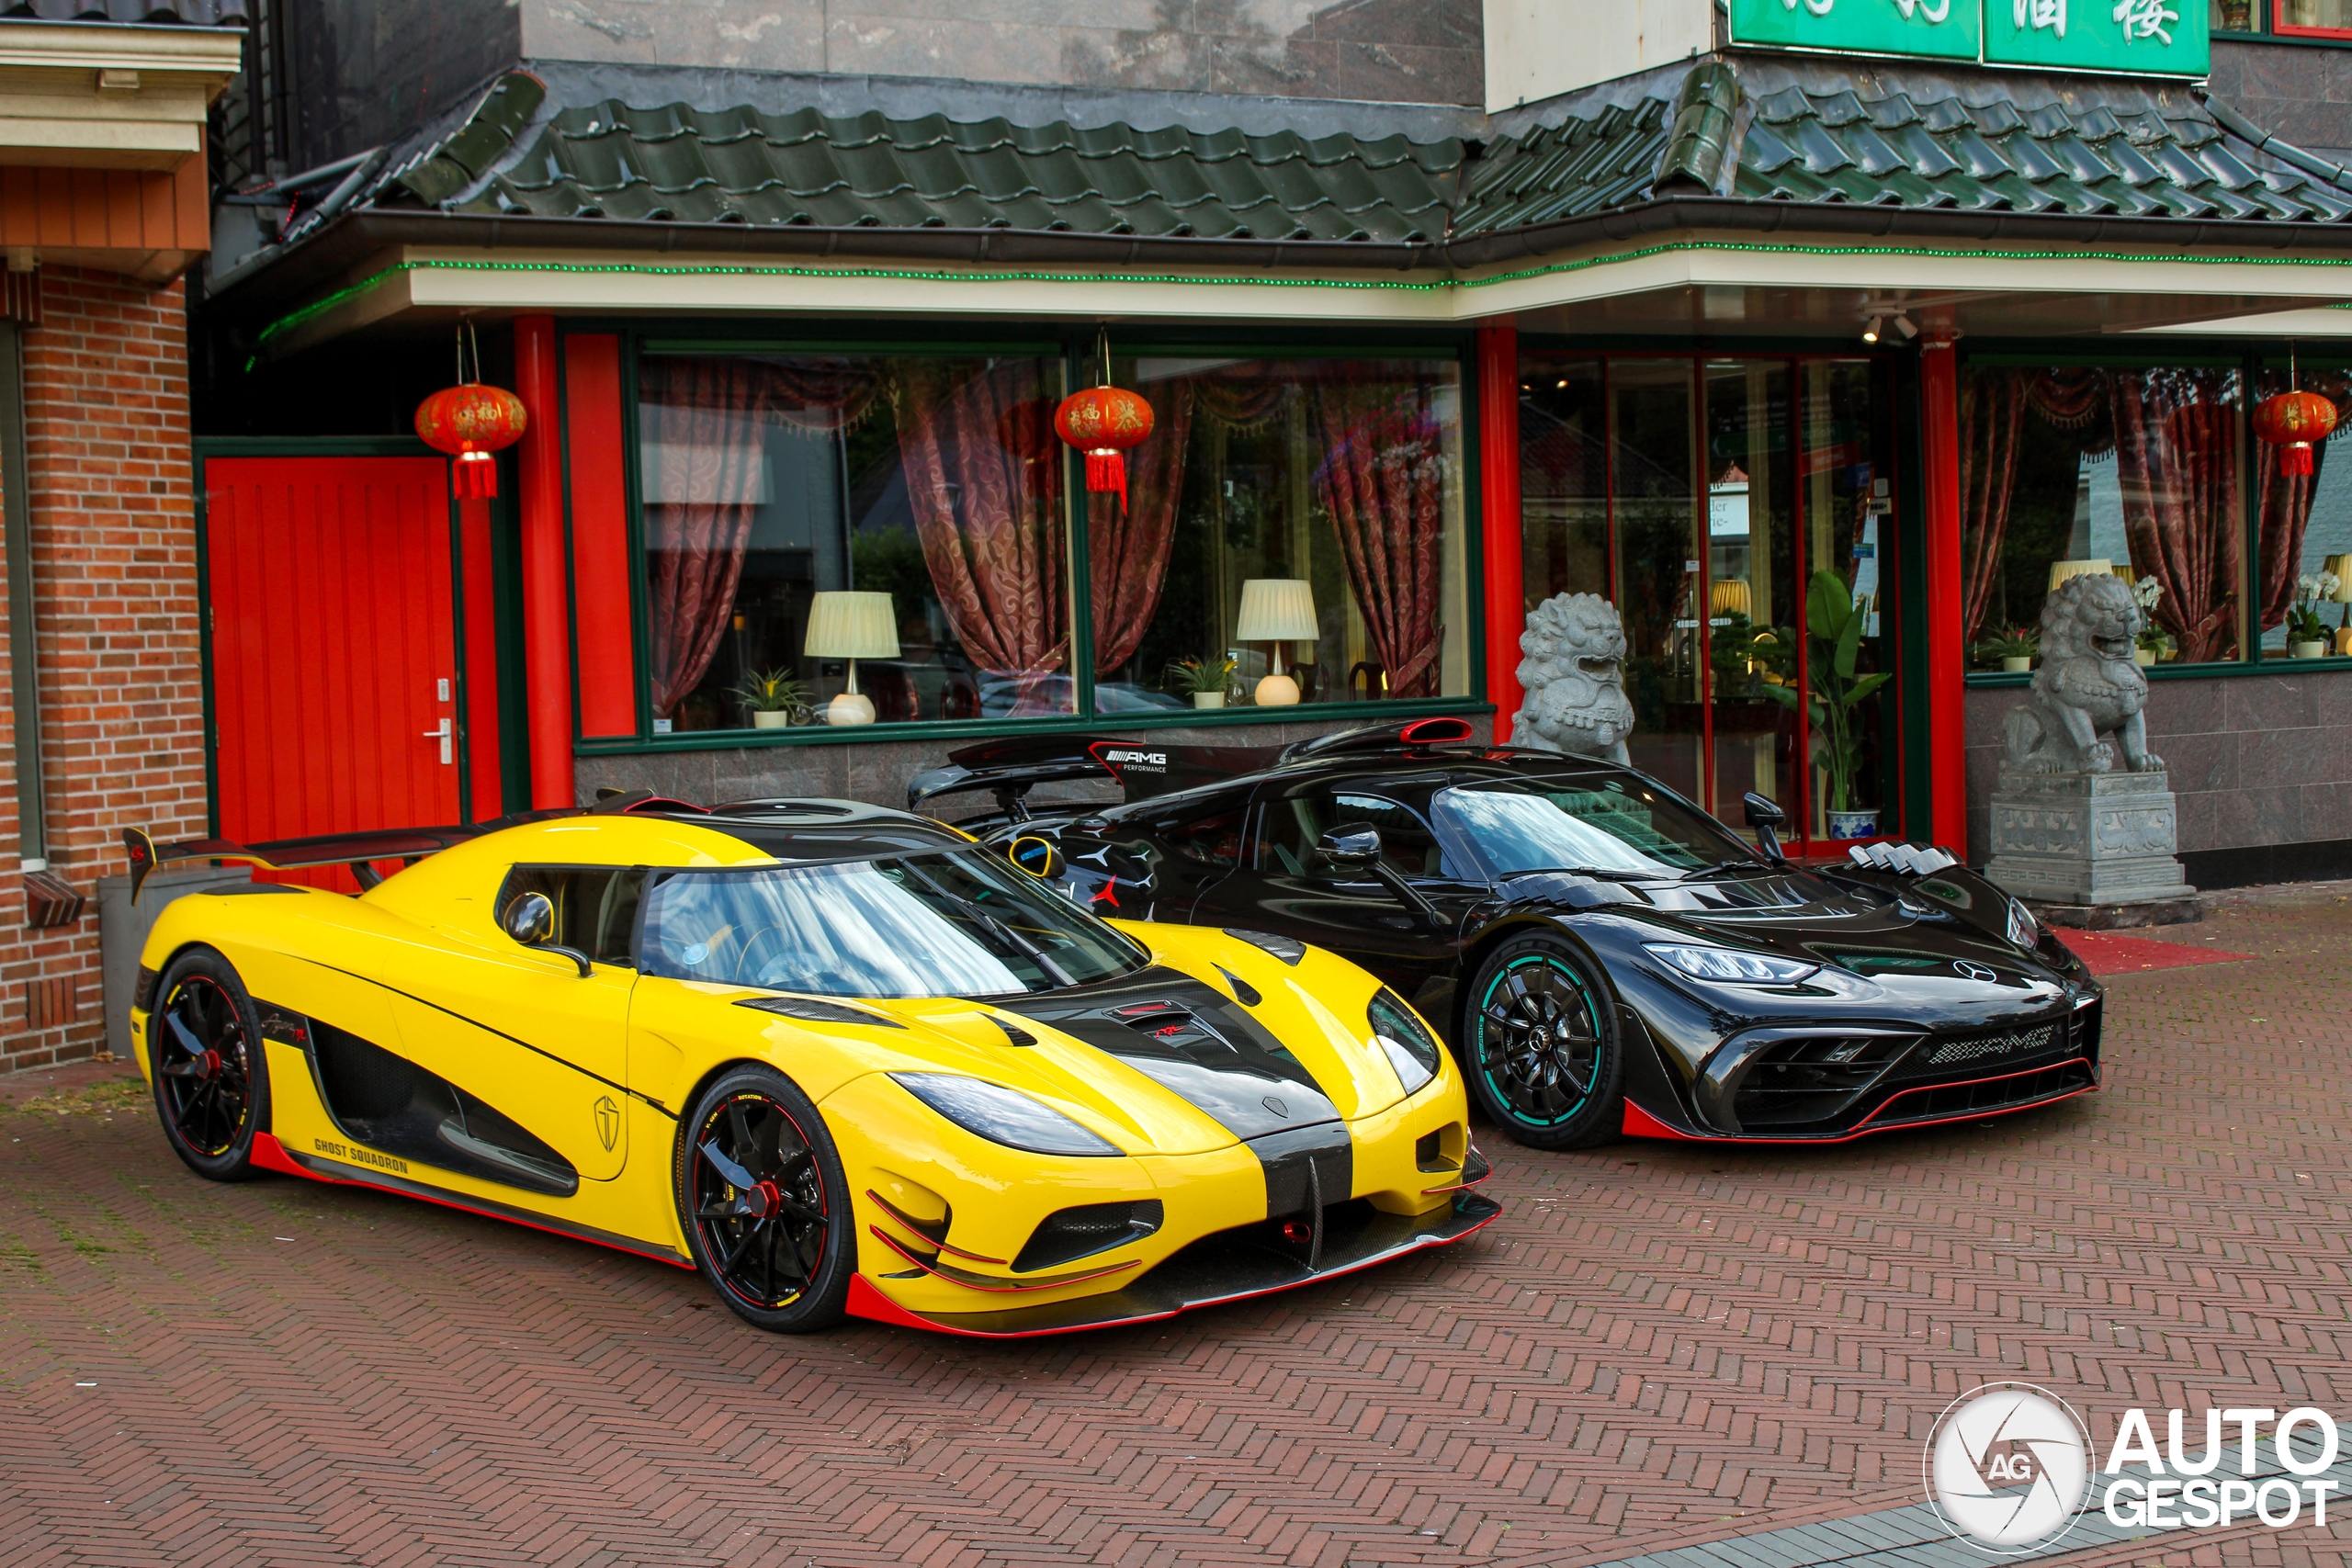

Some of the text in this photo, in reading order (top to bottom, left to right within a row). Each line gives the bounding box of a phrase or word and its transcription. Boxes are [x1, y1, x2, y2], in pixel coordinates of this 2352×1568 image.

[1125, 751, 1167, 764] AMG
[1124, 764, 1167, 773] PERFORMANCE
[314, 1138, 409, 1174] GHOST SQUADRON
